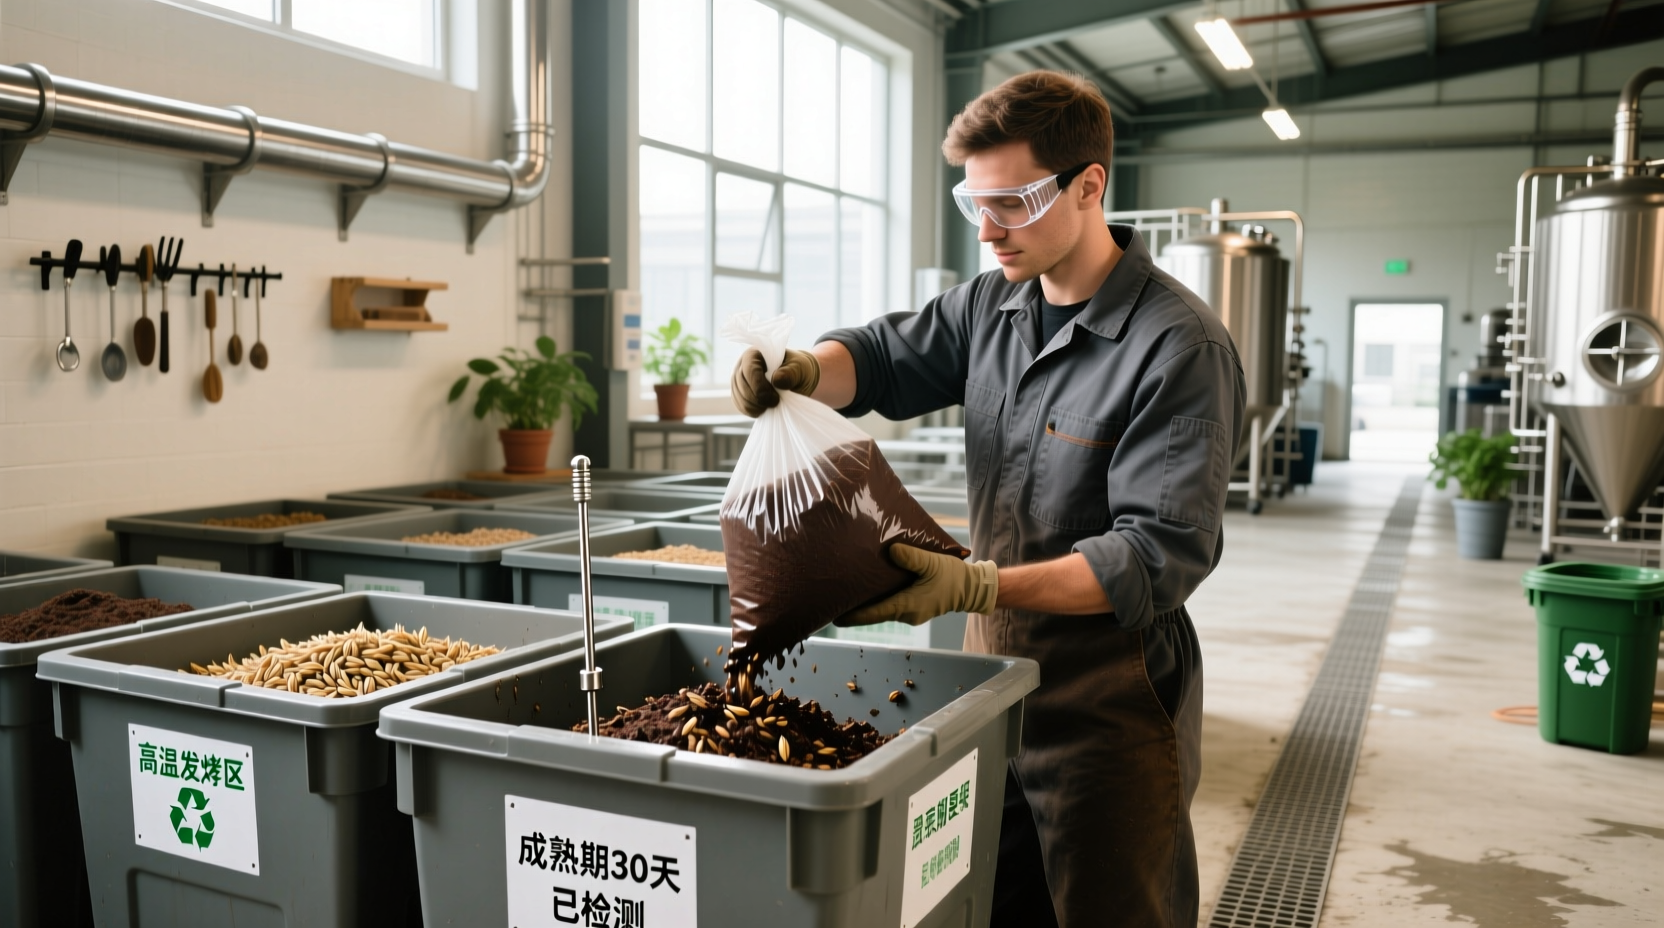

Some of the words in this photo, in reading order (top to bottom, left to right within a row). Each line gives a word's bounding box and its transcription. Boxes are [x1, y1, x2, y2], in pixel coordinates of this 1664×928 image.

[518, 831, 681, 894] 成熟期30天
[553, 886, 645, 928] 已检测
